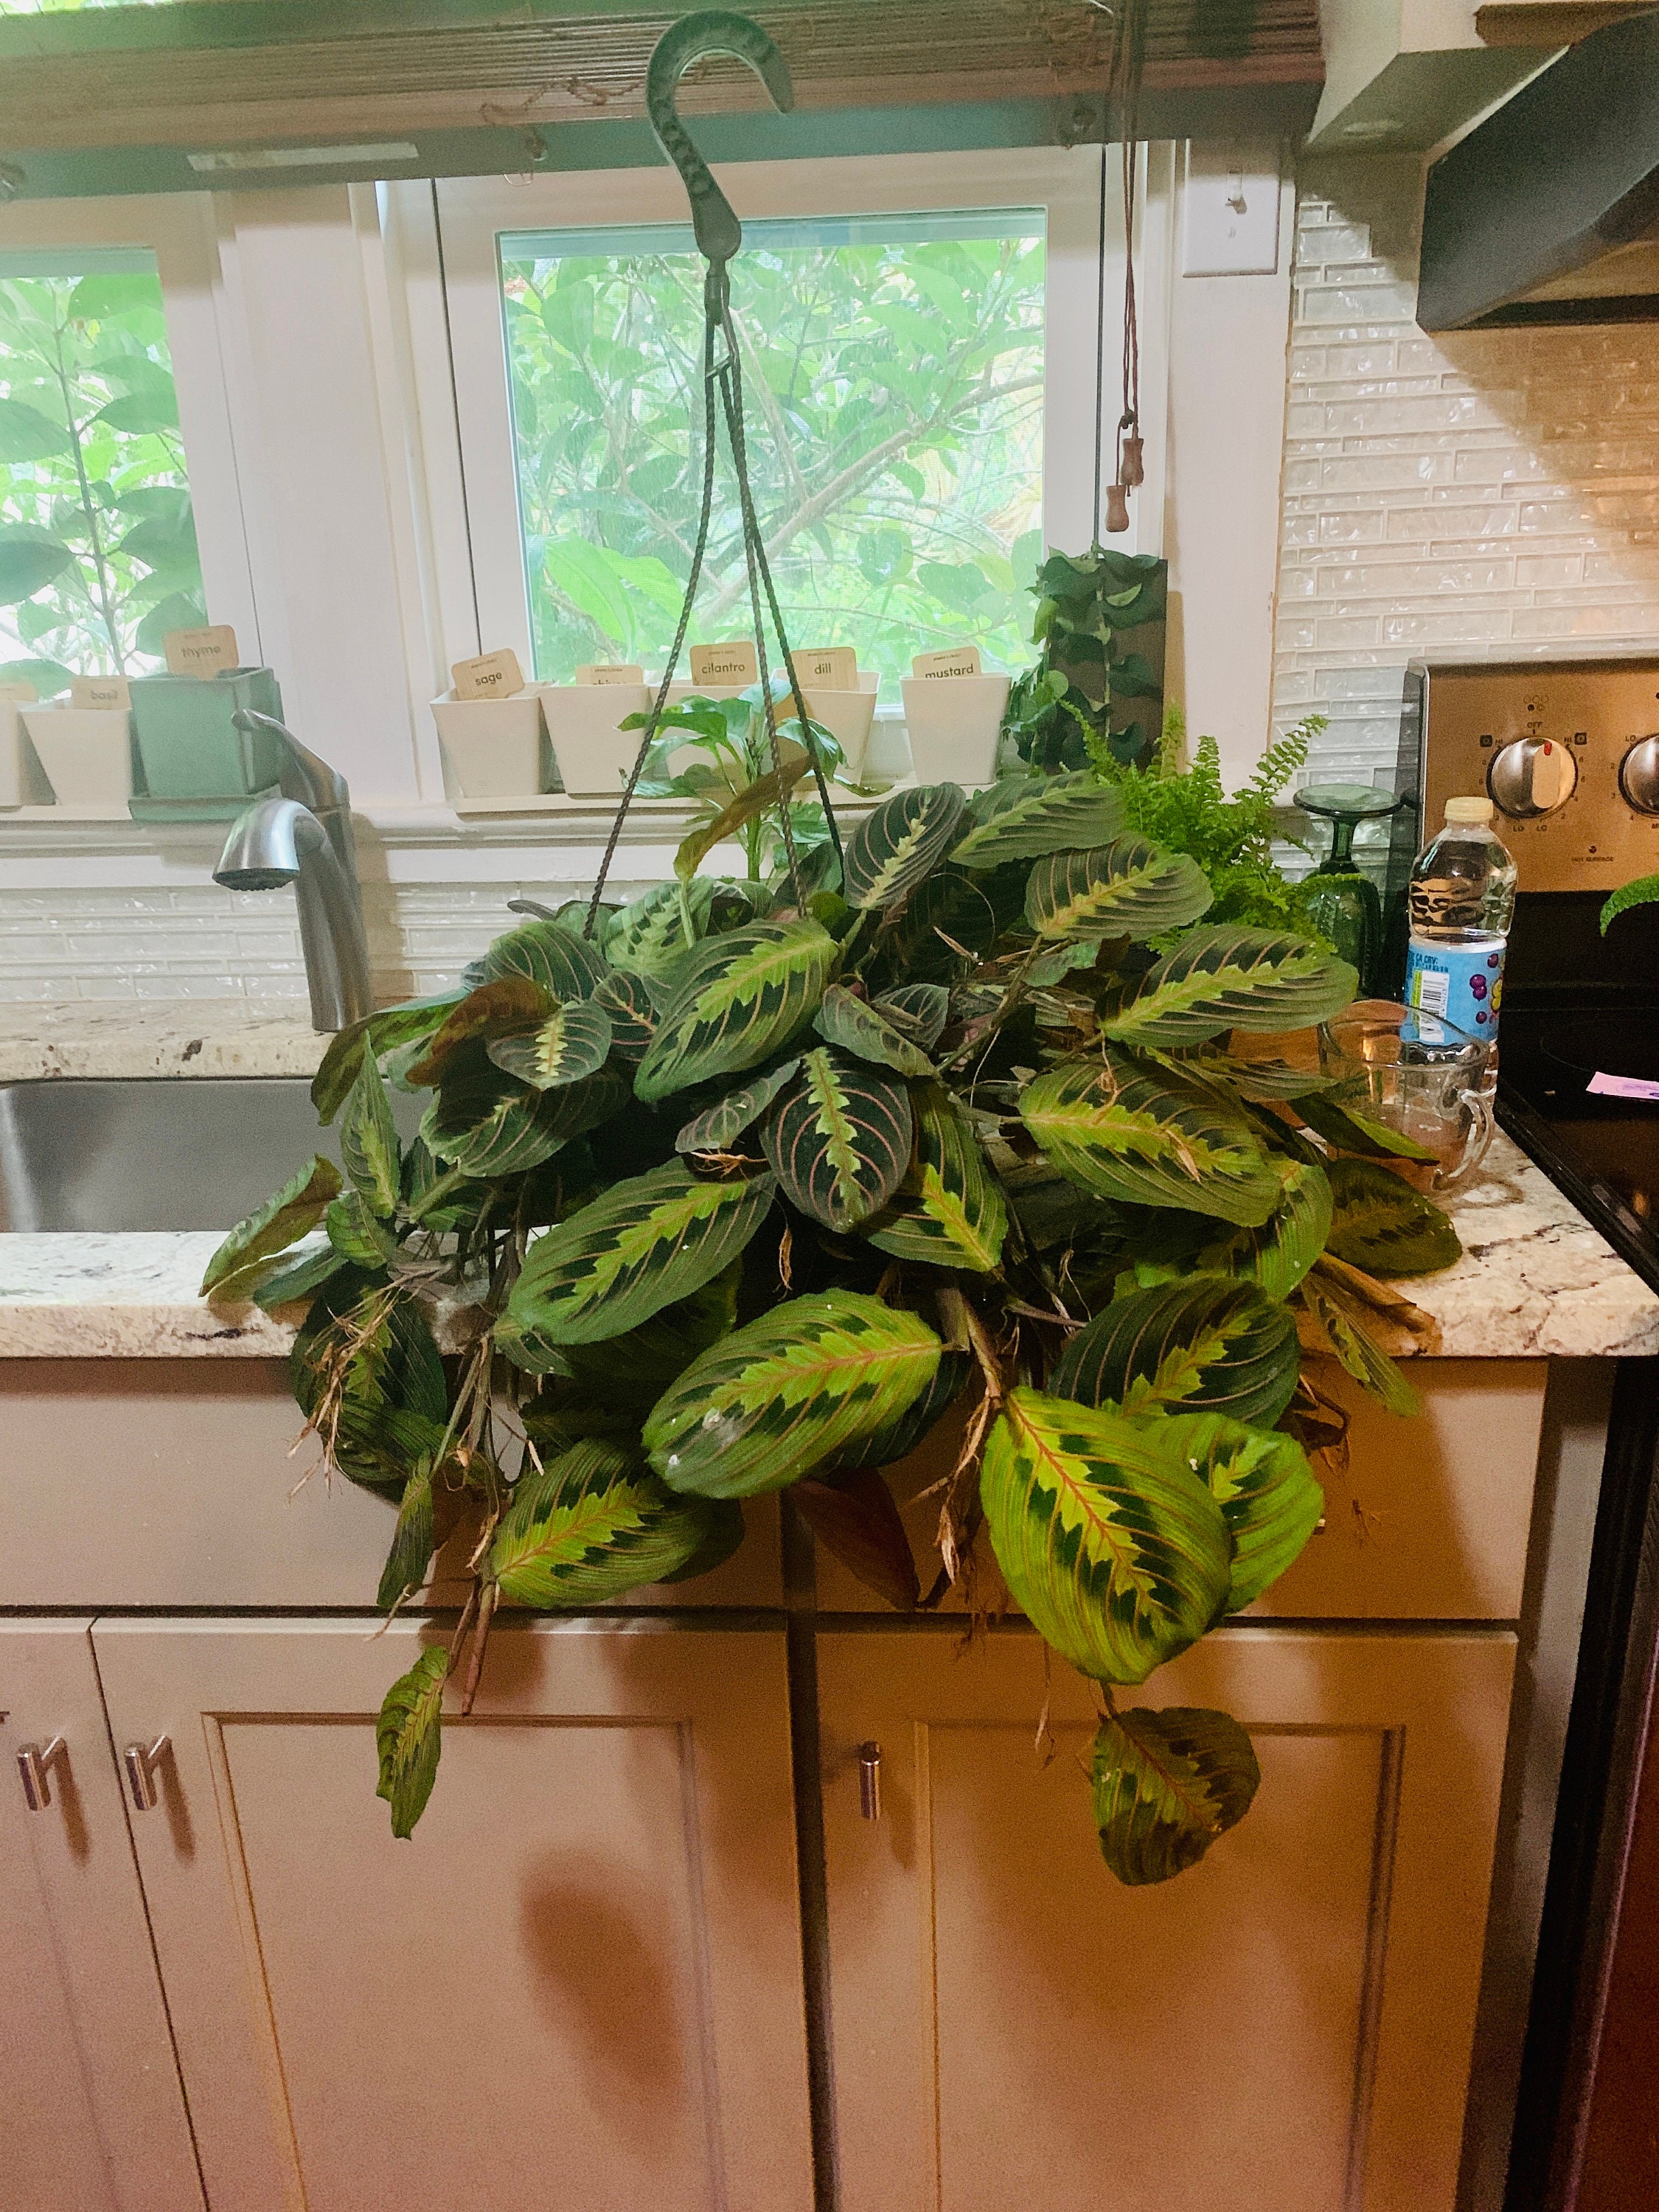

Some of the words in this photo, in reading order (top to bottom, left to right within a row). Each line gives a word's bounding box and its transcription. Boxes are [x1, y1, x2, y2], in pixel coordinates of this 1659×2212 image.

[702, 662, 745, 674] cilantro
[814, 662, 831, 675] dill
[925, 663, 974, 678] mustard
[476, 672, 503, 686] sage
